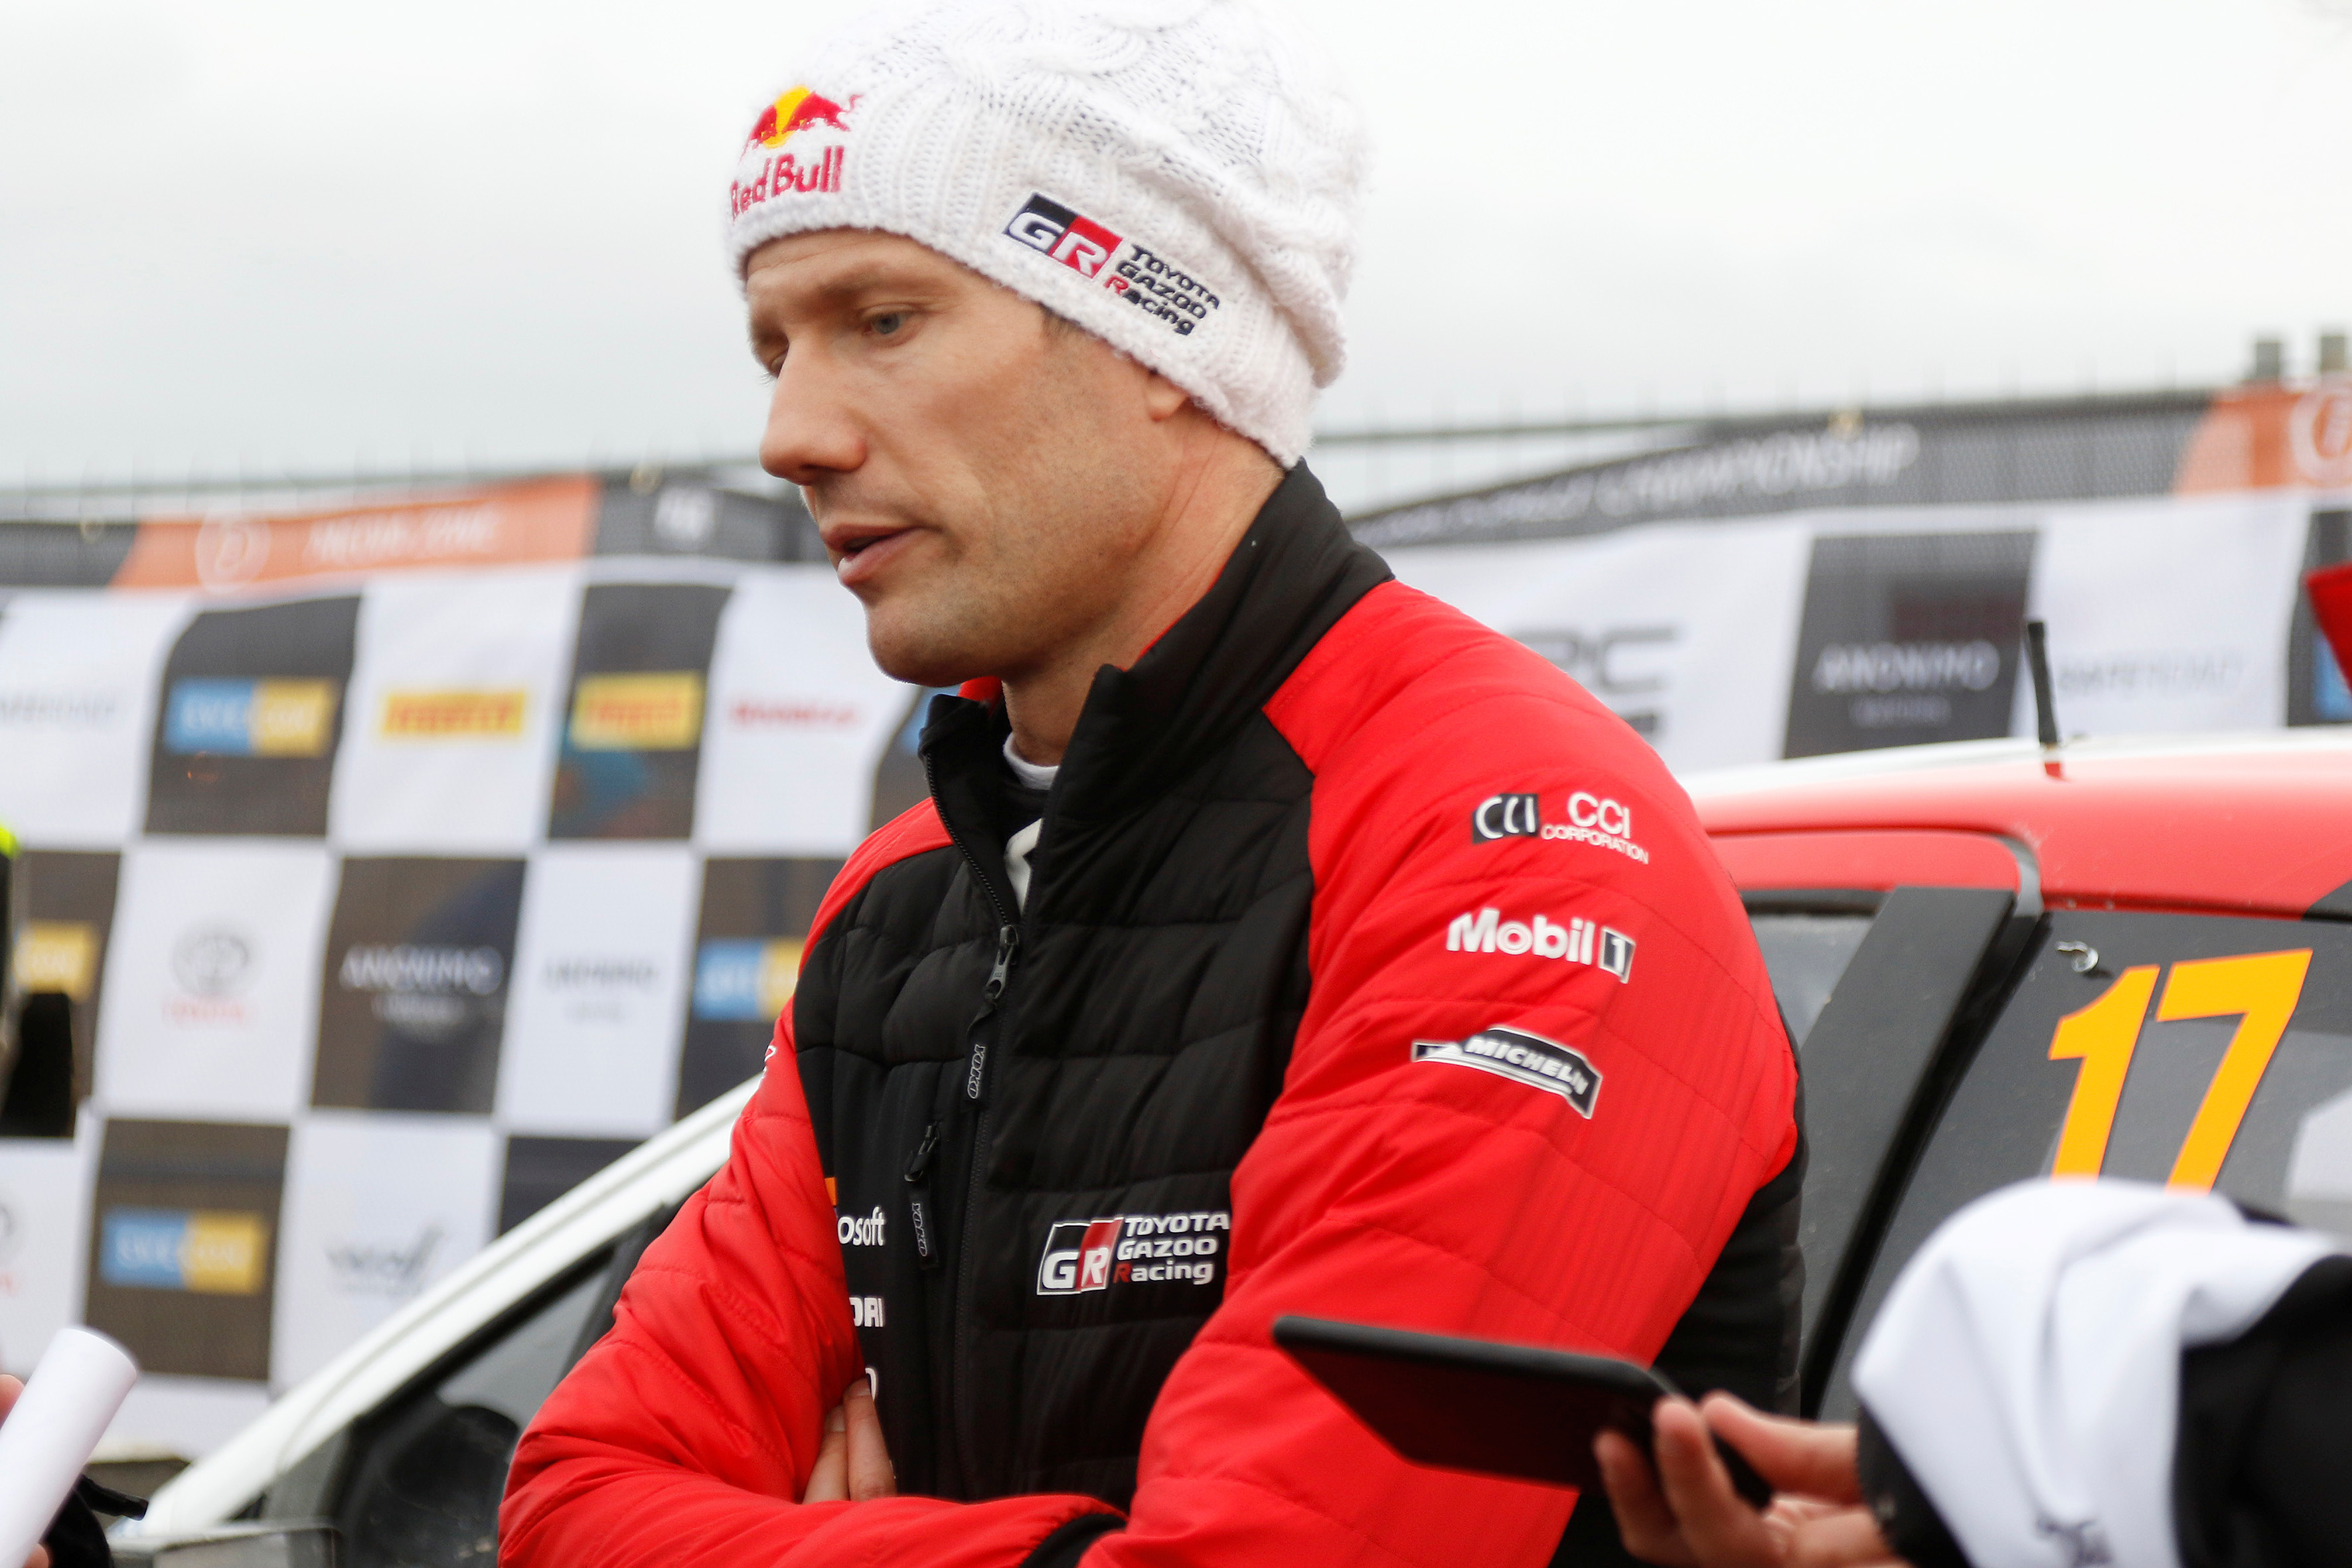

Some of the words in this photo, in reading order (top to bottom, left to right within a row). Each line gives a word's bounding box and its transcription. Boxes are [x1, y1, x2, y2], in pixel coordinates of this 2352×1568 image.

[730, 157, 771, 222] Red
[771, 145, 844, 198] Bull
[1008, 210, 1109, 280] GR
[1115, 260, 1207, 319] GAZOO
[1130, 242, 1220, 310] TOYOTA
[1103, 274, 1195, 335] Racing
[1474, 795, 1537, 840] CCI
[1567, 792, 1632, 840] CCI
[1540, 824, 1650, 865] CORPORATION
[1446, 907, 1596, 966] Mobil
[1464, 1038, 1590, 1095] MICHELIN
[2048, 948, 2315, 1197] 17
[837, 1205, 886, 1247] osoft
[1117, 1237, 1219, 1261] GAZOO
[1125, 1213, 1230, 1237] TOYOTA
[1042, 1247, 1109, 1289] GR
[1112, 1260, 1214, 1285] Racing
